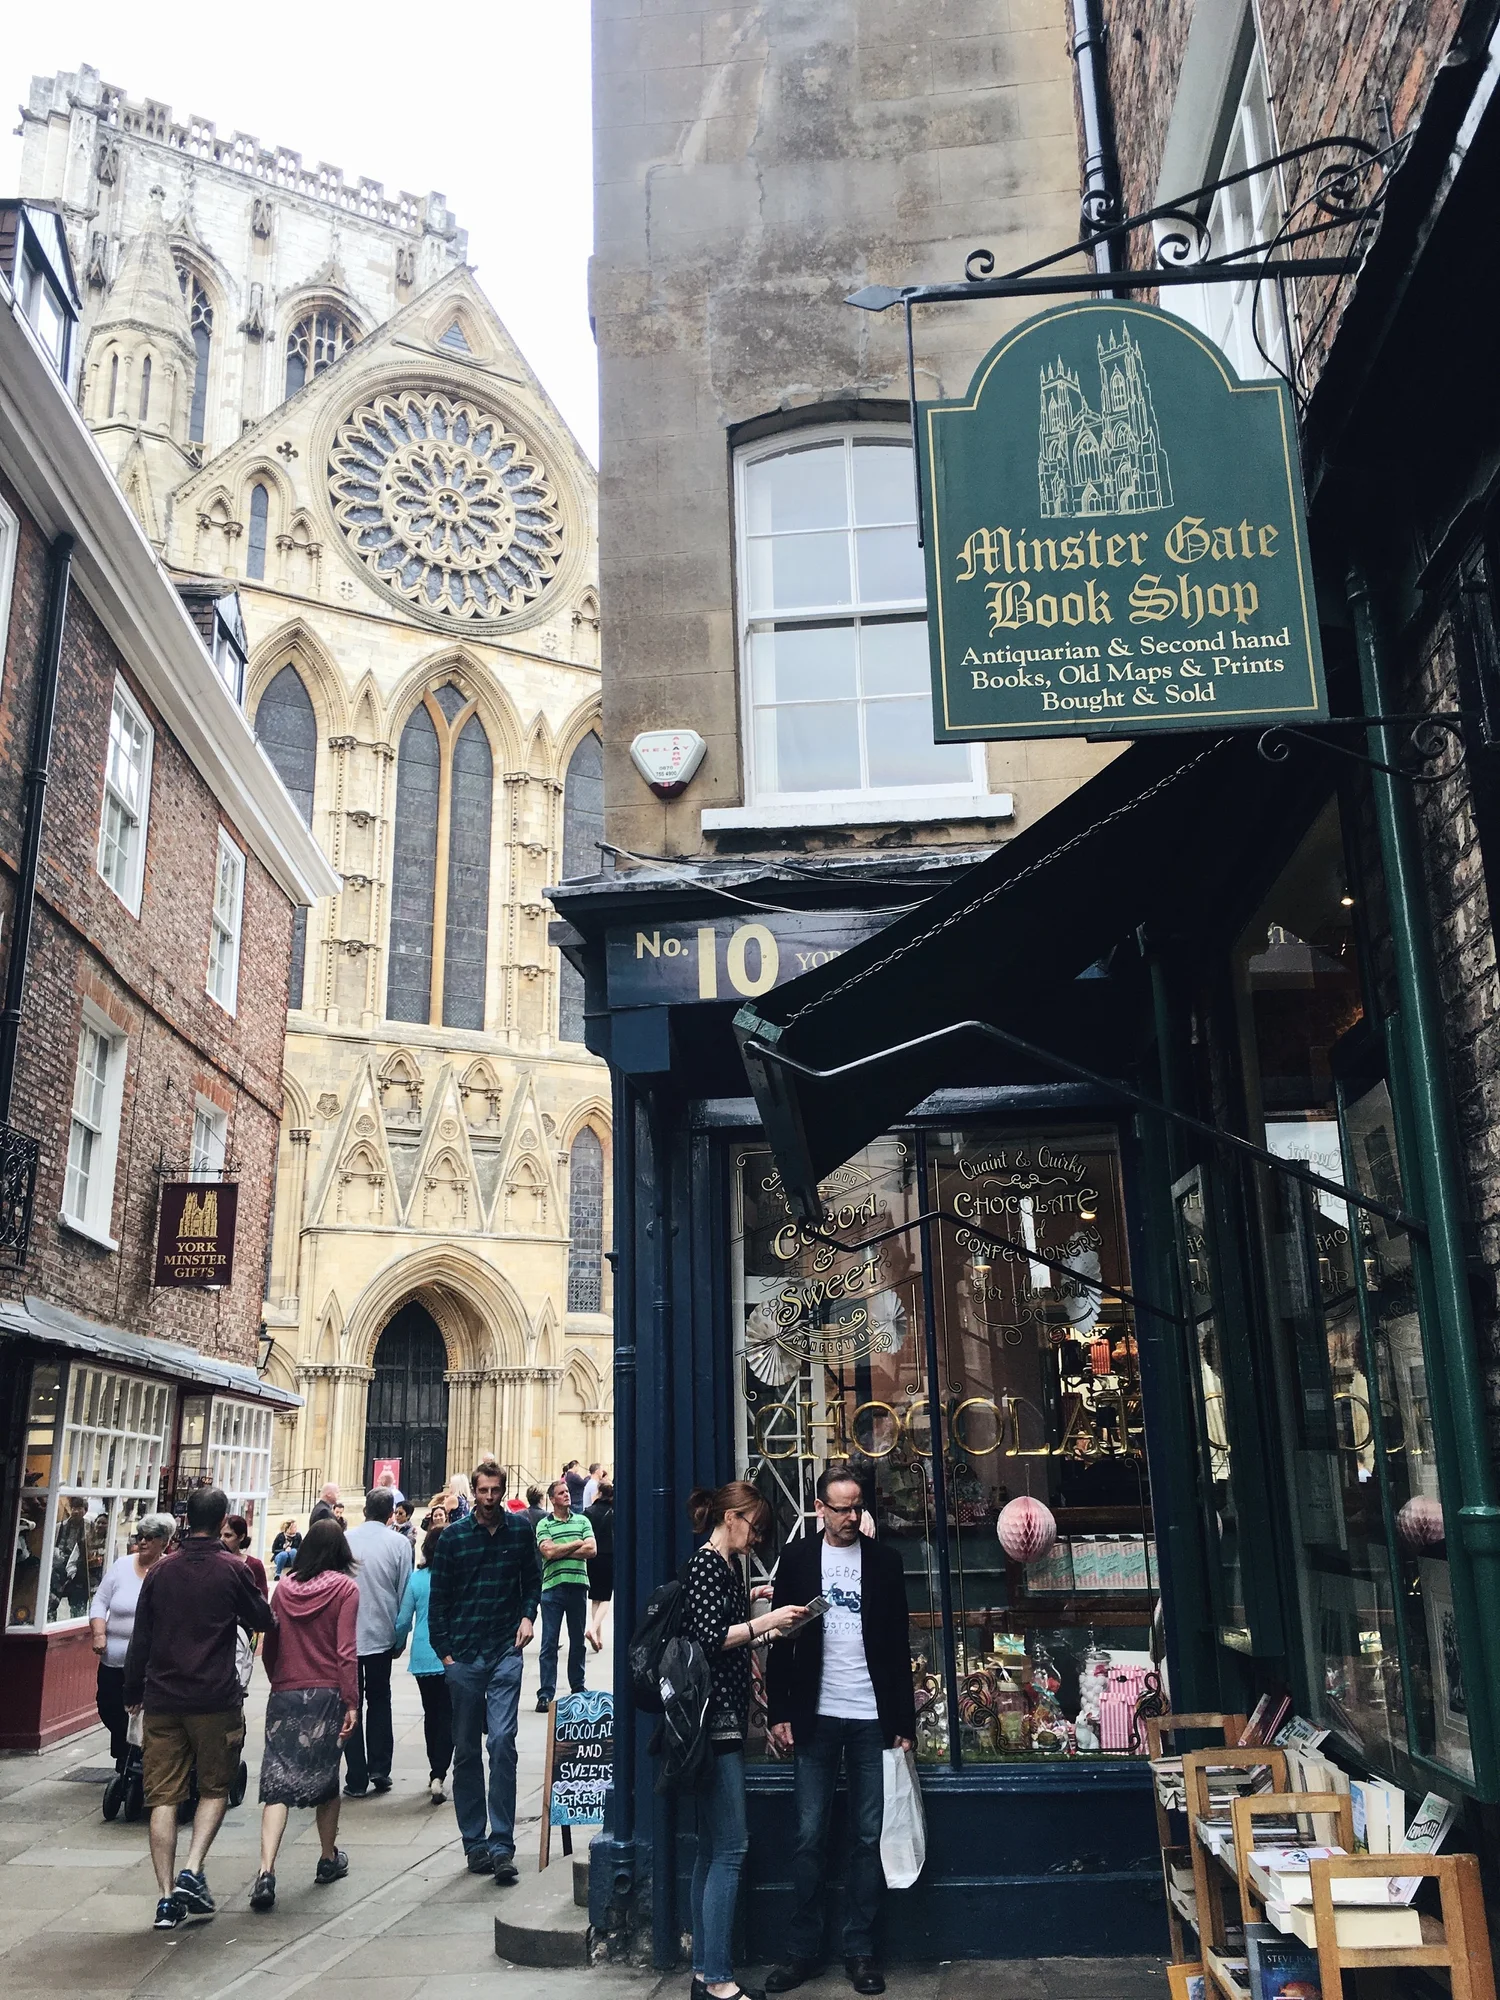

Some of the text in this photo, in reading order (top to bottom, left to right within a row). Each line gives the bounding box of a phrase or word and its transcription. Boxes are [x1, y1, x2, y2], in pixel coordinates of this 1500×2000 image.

[956, 515, 1280, 583] Minster Gate
[984, 573, 1259, 638] Book Shop
[960, 627, 1291, 667] Antiquarian & Second hand
[970, 655, 1285, 690] Books, Old Maps & Prints
[1041, 681, 1216, 713] Bought & Sold
[636, 923, 780, 1000] No. 10
[960, 1145, 1087, 1182] Quaint & Quirky
[163, 1254, 227, 1266] MINSTER
[175, 1242, 217, 1253] YORK
[955, 1225, 1103, 1263] CONFECIONERY
[174, 1267, 215, 1278] GIFTS
[792, 1318, 881, 1353] CONFECTIONS
[822, 1621, 862, 1629] USTOM
[556, 1720, 613, 1741] CHOCOLAT
[576, 1744, 602, 1758] AND
